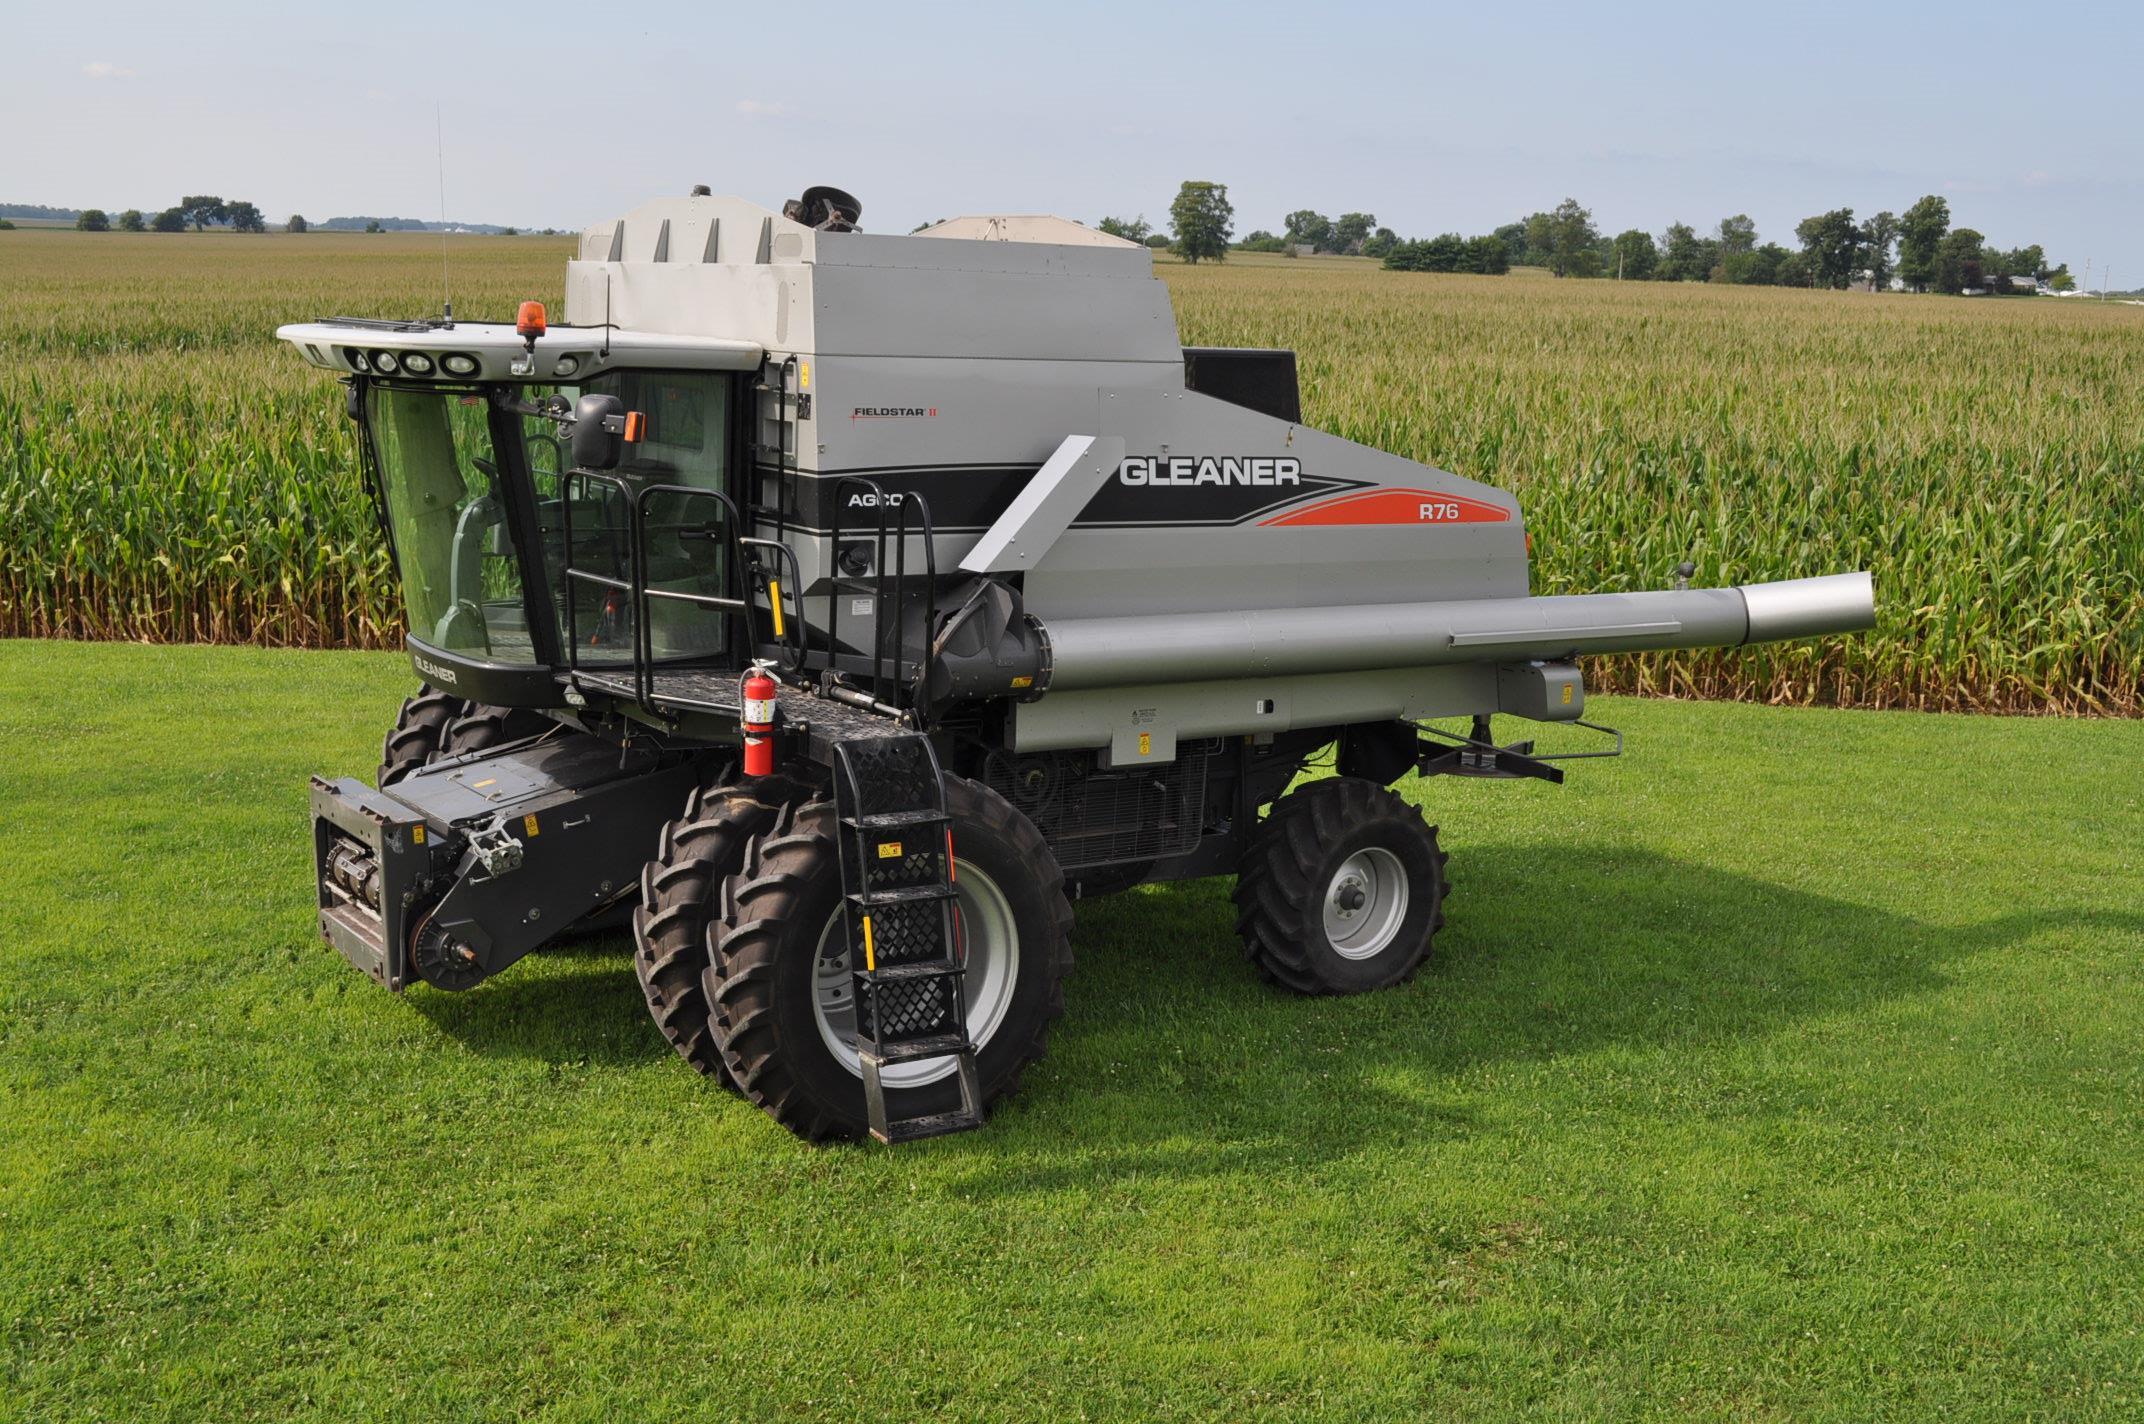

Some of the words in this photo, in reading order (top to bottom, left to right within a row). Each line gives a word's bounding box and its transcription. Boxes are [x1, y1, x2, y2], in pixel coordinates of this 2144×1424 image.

[854, 407, 924, 416] FIELDSTAR
[1119, 457, 1301, 486] GLEANER
[1419, 503, 1459, 520] R76
[414, 654, 457, 685] GLEANER
